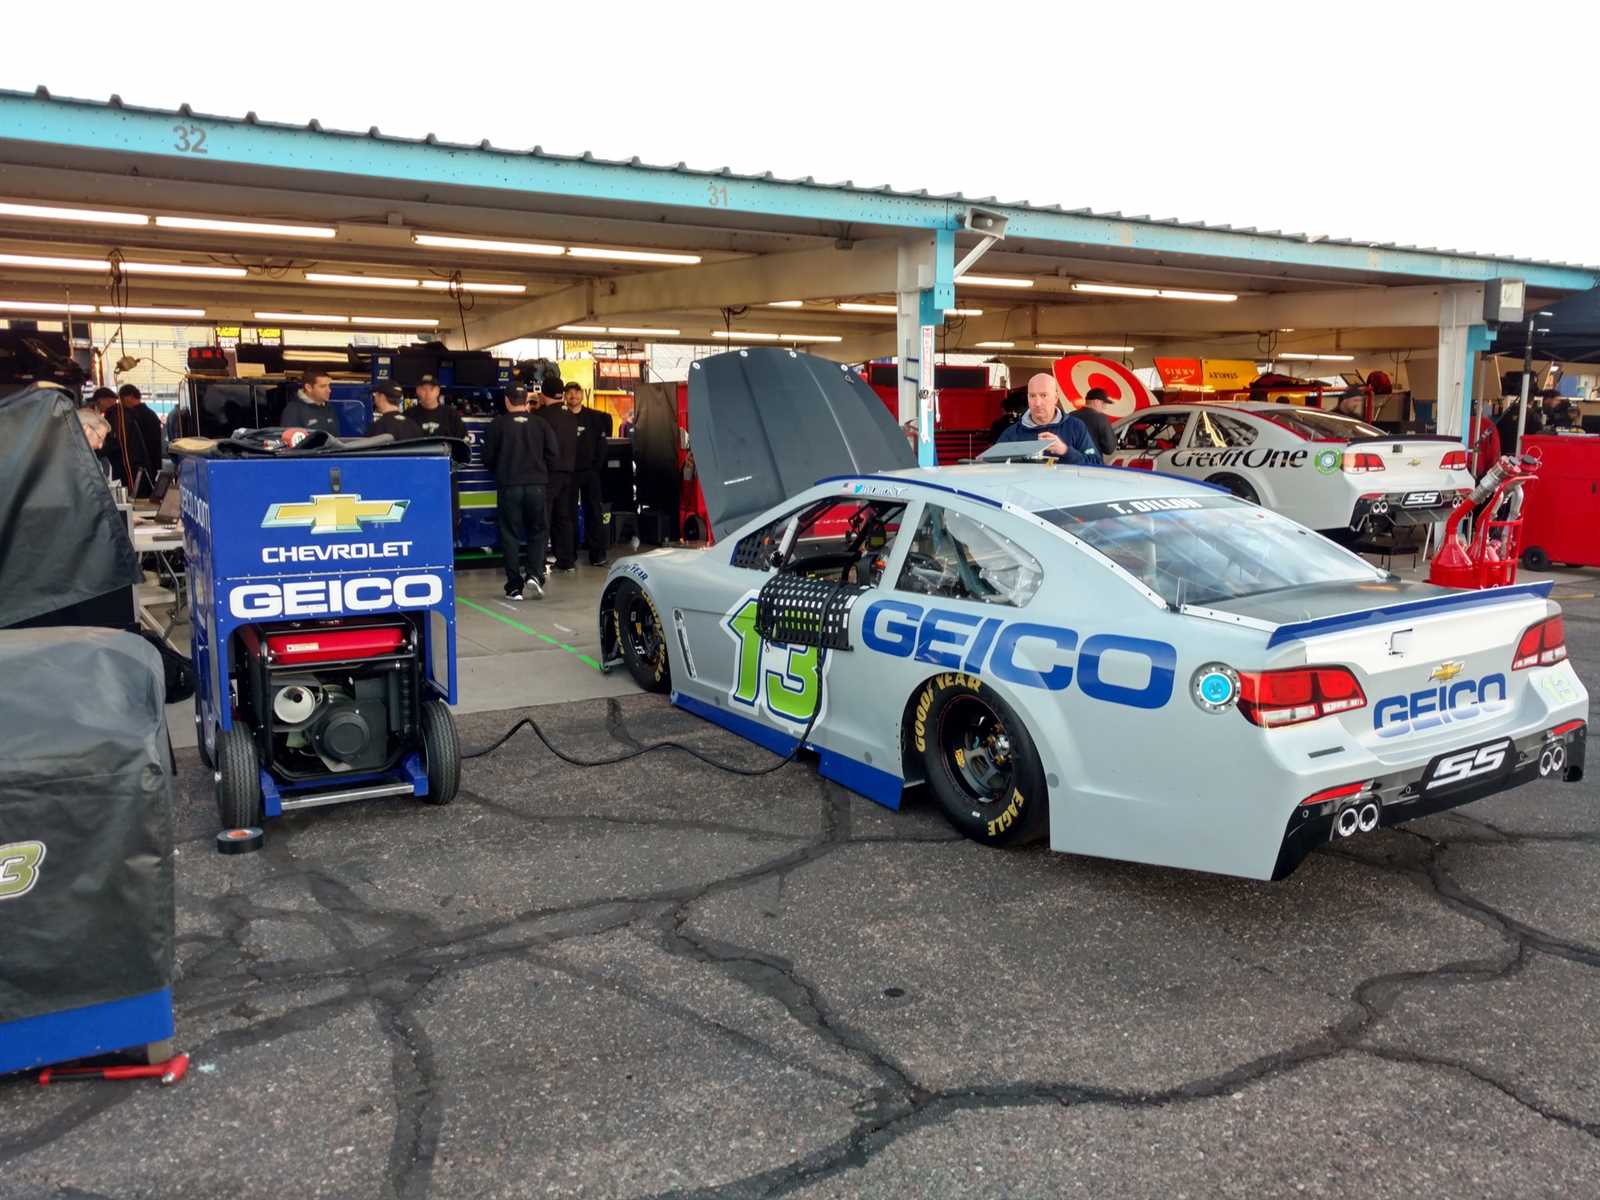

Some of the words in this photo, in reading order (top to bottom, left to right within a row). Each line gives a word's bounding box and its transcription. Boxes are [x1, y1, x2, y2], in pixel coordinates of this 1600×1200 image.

[173, 126, 208, 154] 32
[707, 185, 728, 209] 31
[1107, 503, 1133, 515] T.
[1129, 498, 1203, 513] DILLON
[1404, 492, 1440, 505] SS
[262, 540, 413, 564] CHEVROLET
[229, 574, 443, 619] GEICO
[861, 599, 1178, 710] GEICO
[1373, 672, 1507, 737] GEICO
[1425, 740, 1511, 790] SS
[987, 787, 1025, 837] EAGLE
